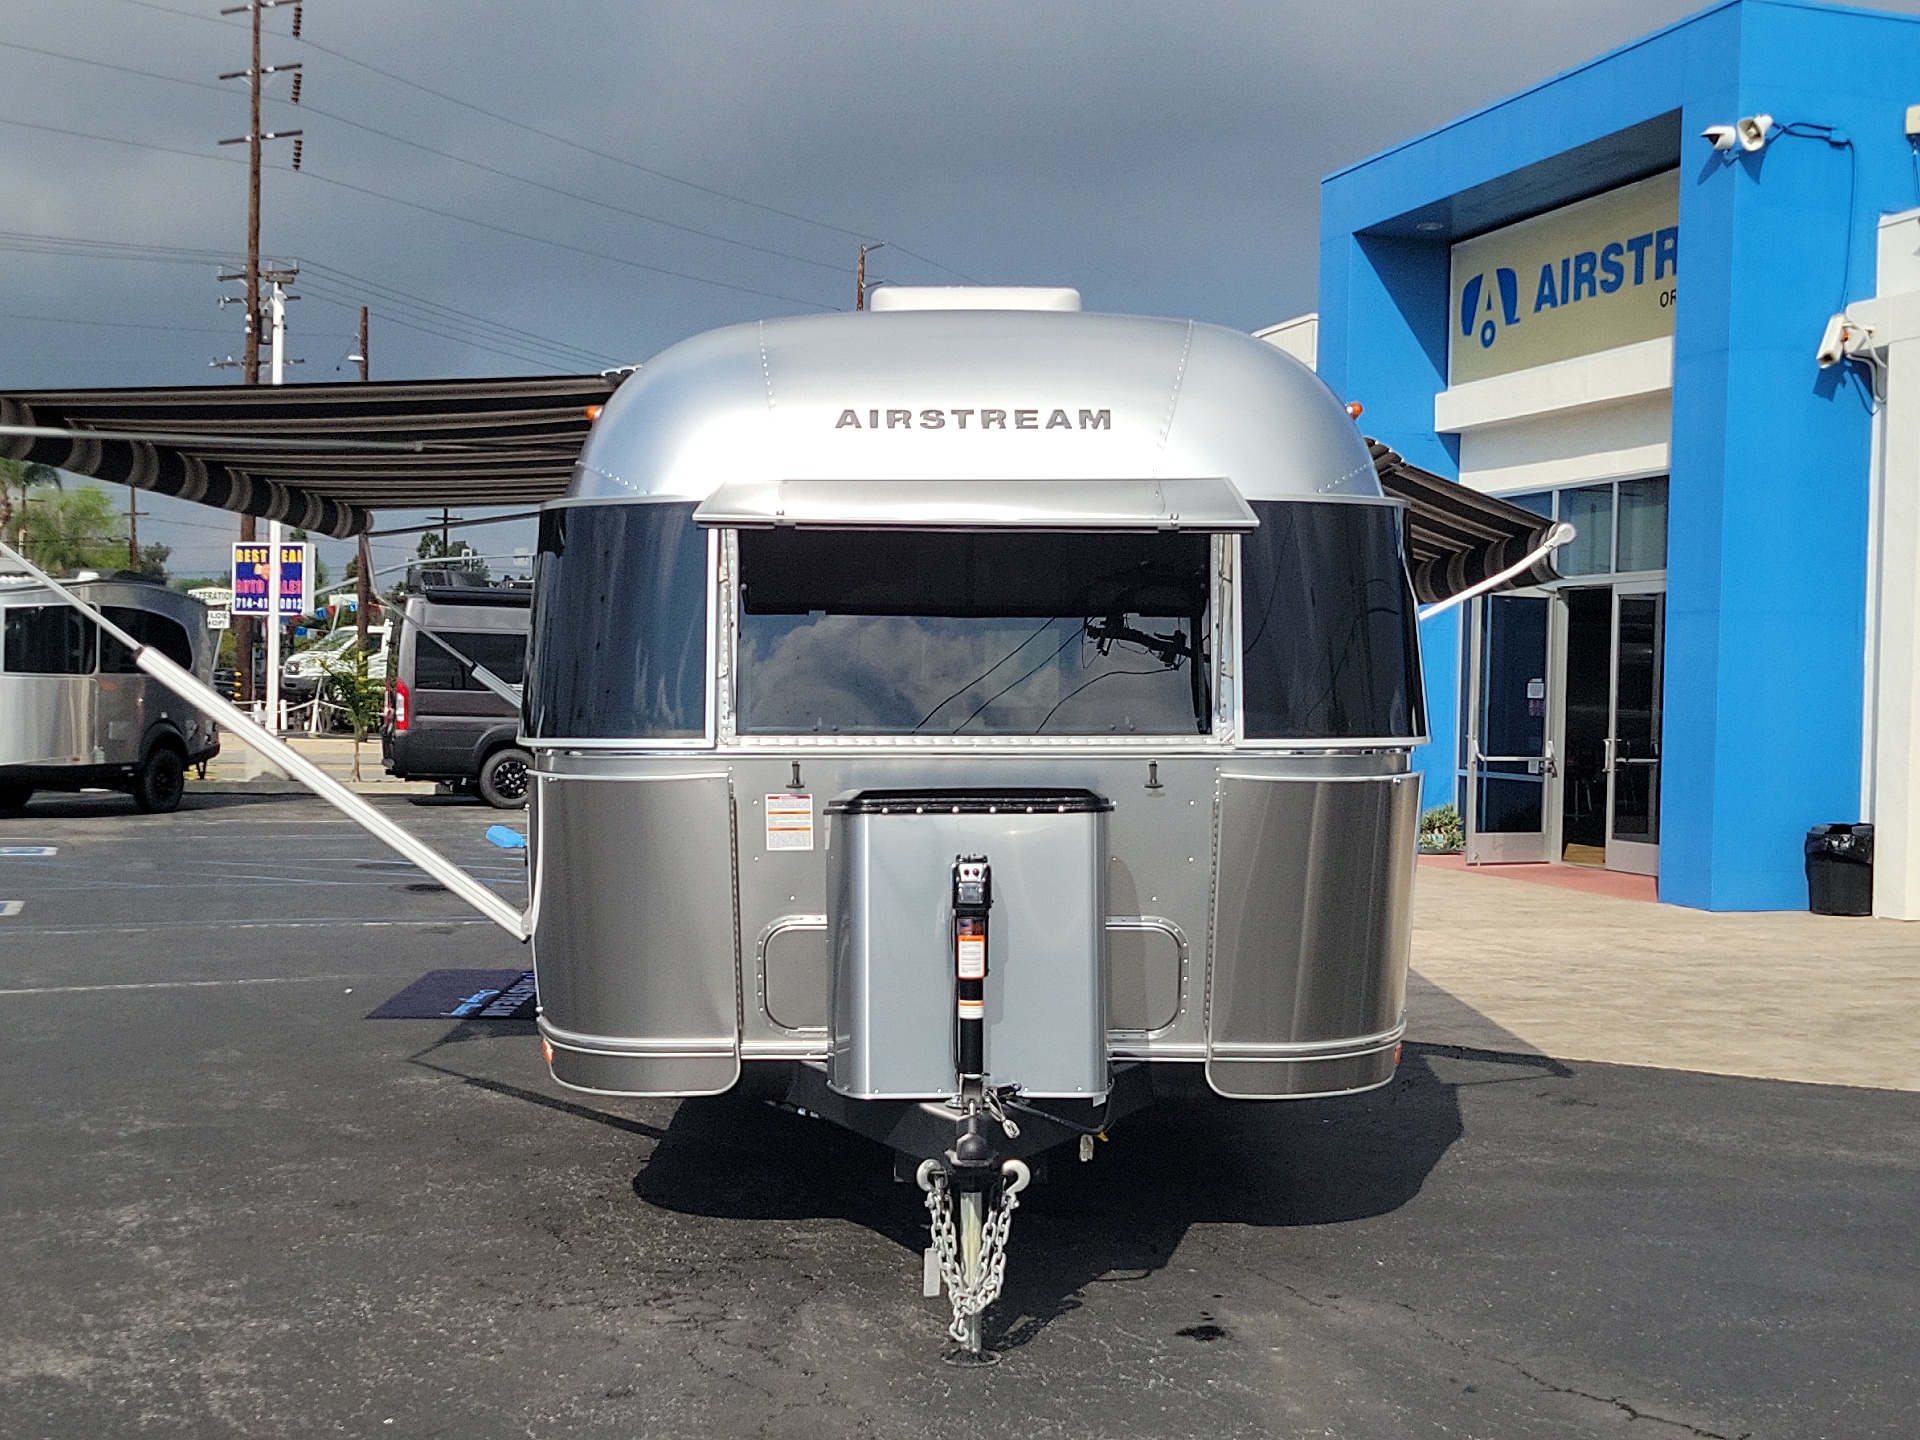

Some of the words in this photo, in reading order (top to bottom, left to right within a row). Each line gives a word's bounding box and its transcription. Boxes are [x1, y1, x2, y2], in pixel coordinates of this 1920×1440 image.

[1533, 226, 1678, 313] AIRSTR
[835, 409, 1111, 430] AIRSTREAM
[235, 548, 268, 563] BEST
[281, 548, 304, 563] EAL
[236, 580, 265, 594] AUTO
[236, 597, 303, 610] 714-410012
